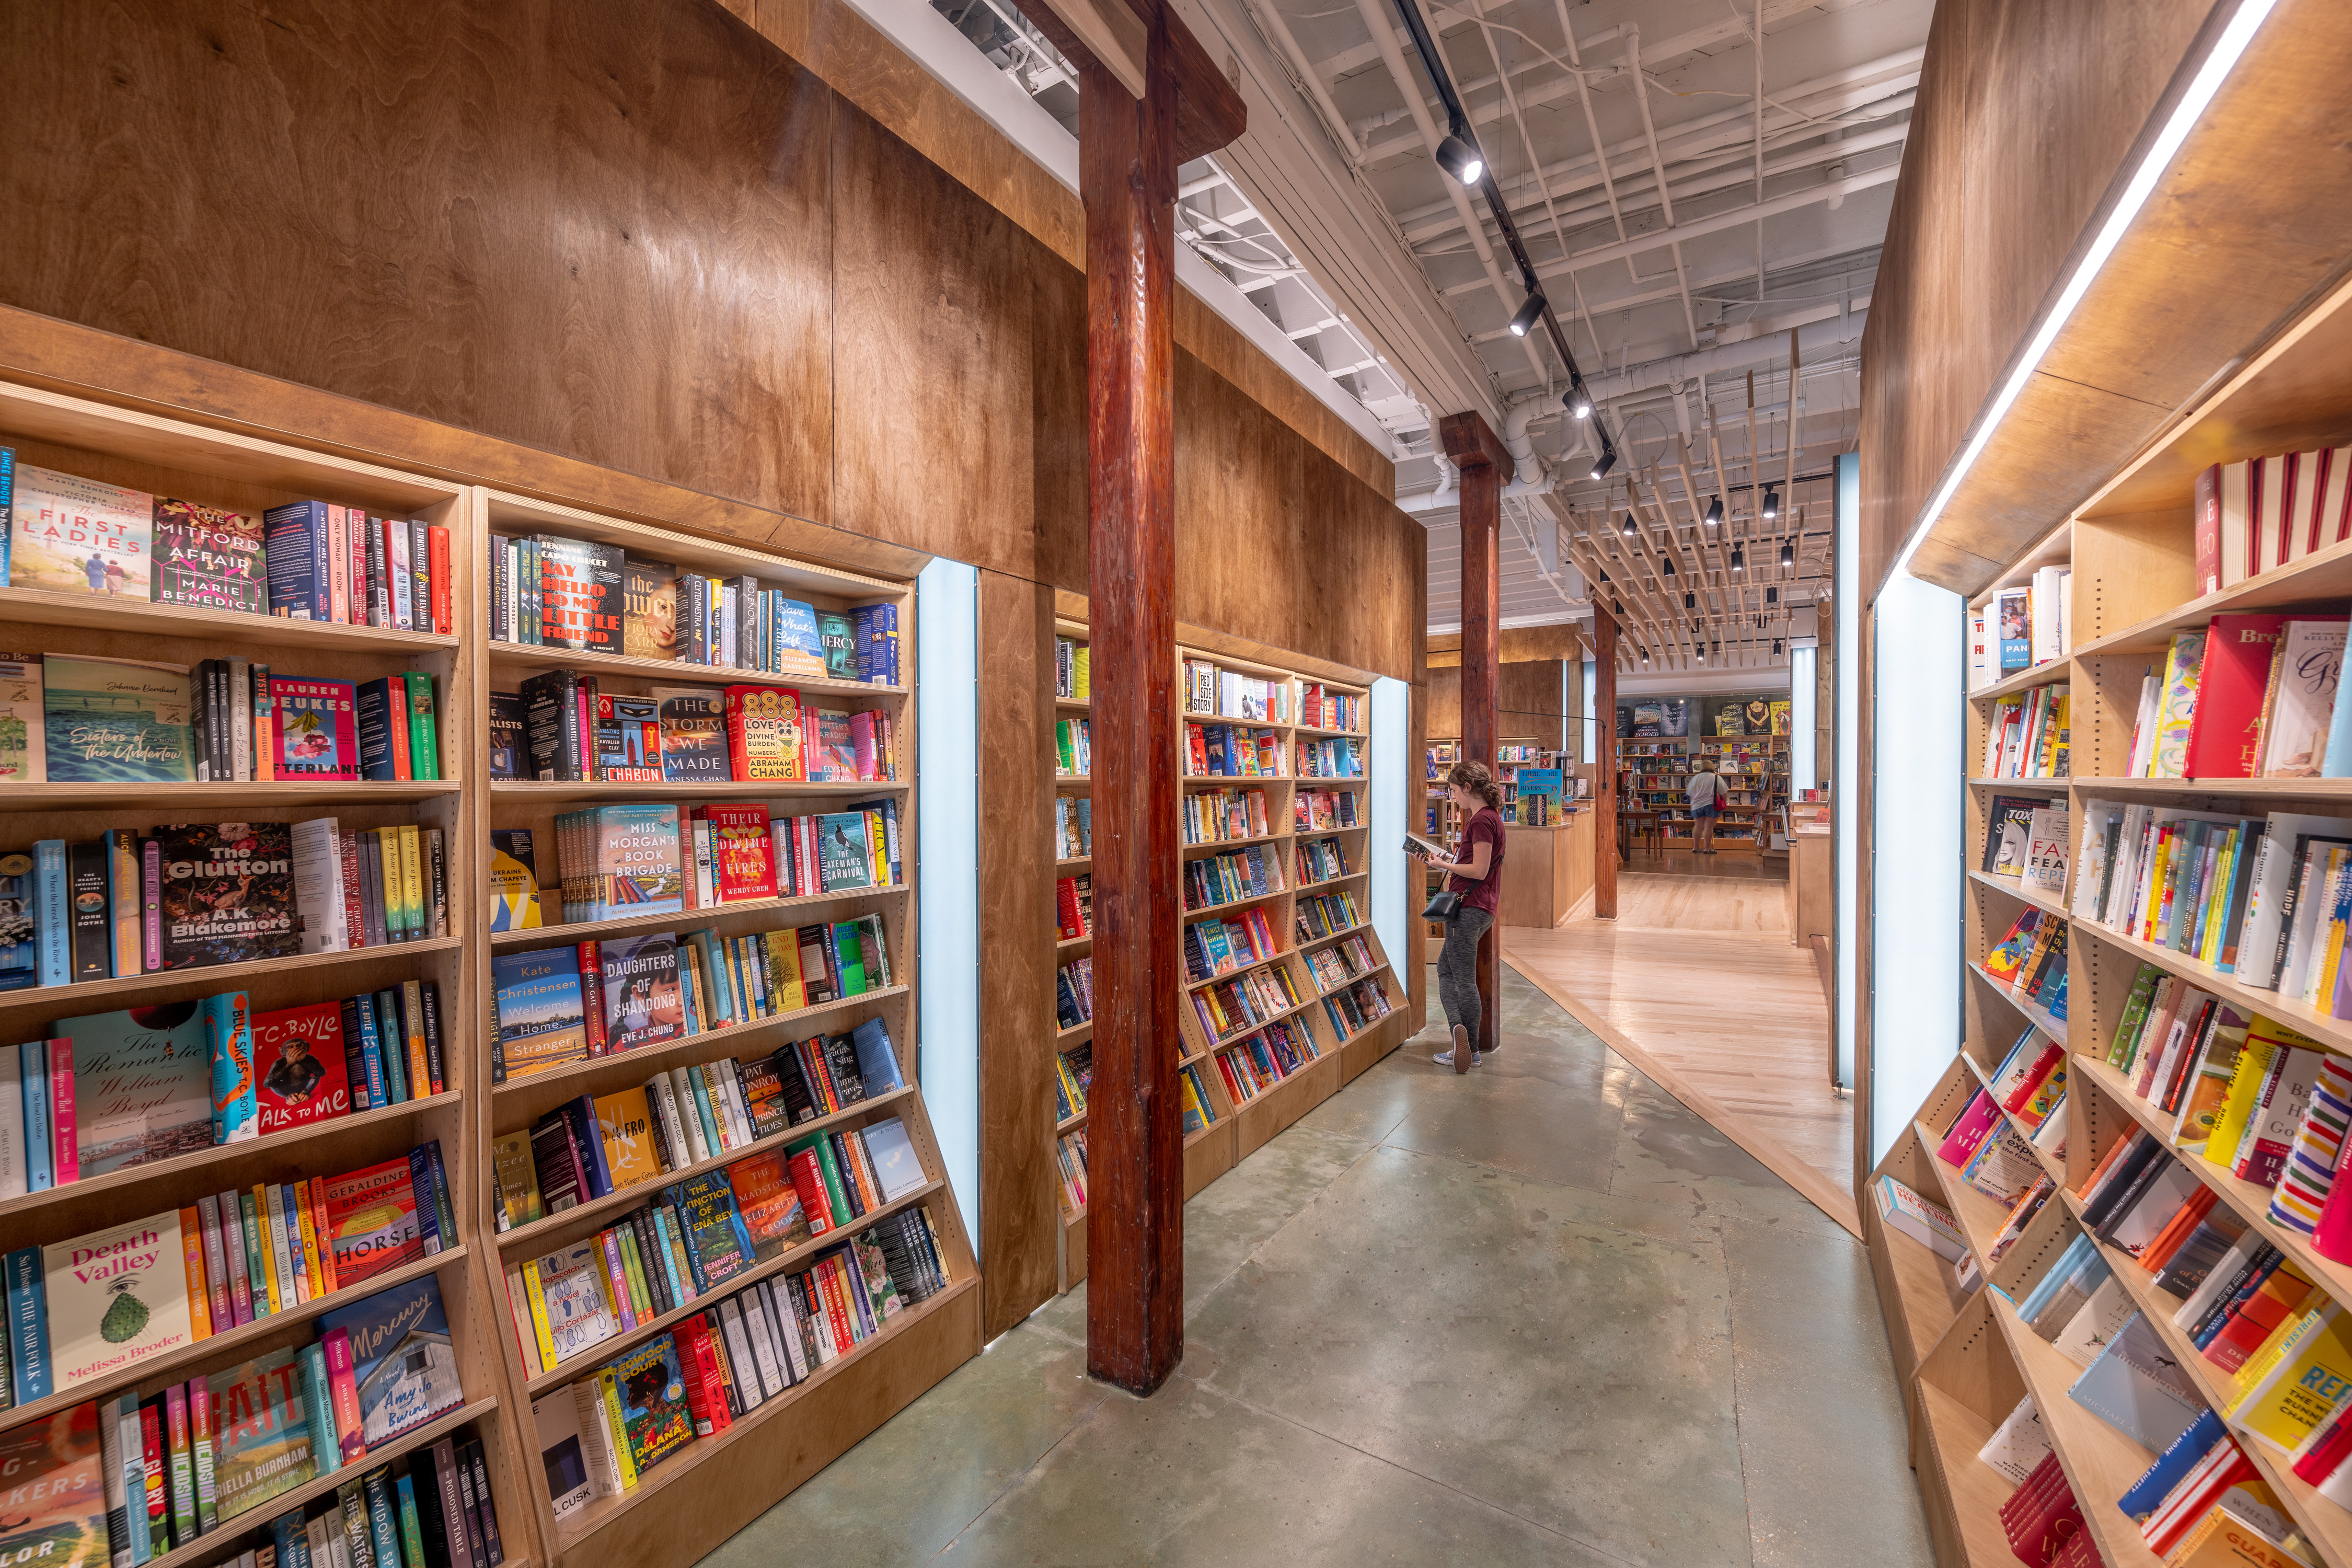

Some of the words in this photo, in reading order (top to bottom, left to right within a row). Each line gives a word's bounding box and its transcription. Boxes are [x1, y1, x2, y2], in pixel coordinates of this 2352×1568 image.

[47, 477, 76, 487] MARIE
[81, 485, 124, 498] BENEDICT
[64, 490, 107, 503] VICTORIA
[32, 487, 96, 504] CHRISTOPHER
[101, 503, 136, 514] MURRAY
[39, 508, 128, 536] FIRST
[194, 511, 225, 524] THE
[24, 520, 140, 553] LADIES
[156, 521, 260, 551] MITFORD
[541, 541, 582, 554] JENNINE
[169, 547, 249, 570] AFFAIR
[541, 551, 570, 563] CAPÓ
[572, 555, 607, 567] CRUCET
[541, 560, 576, 577] SAY
[542, 577, 606, 597] HELLO
[543, 593, 569, 606] TO
[573, 596, 601, 611] MY
[543, 607, 620, 630] LITTLE
[543, 626, 609, 643] FRIEND
[783, 663, 822, 673] CASTELLANO
[785, 655, 817, 665] ELIZABETH
[107, 682, 141, 691] Johnnie
[143, 684, 178, 696] Bernhard
[257, 673, 267, 704] OYSTER
[276, 684, 339, 696] LAUREN
[1201, 675, 1210, 686] RED
[1200, 687, 1211, 699] SIDE
[271, 697, 351, 711] BEUKES
[672, 699, 708, 712] THE
[742, 690, 798, 720] 888
[1194, 698, 1210, 711] STORY
[660, 718, 723, 732] STORM
[745, 720, 774, 730] LOVE
[70, 727, 126, 744] Sisters
[134, 729, 147, 750] of
[79, 745, 111, 761] the
[114, 744, 182, 763] Undertow
[668, 757, 721, 770] MADE
[608, 768, 660, 782] CHABON
[750, 768, 792, 778] CHANG
[631, 822, 656, 834] MISS
[721, 813, 760, 825] THEIR
[331, 825, 340, 855] BYCATCH
[609, 835, 675, 849] MORGAN'S
[719, 837, 768, 851] DIVINE
[874, 821, 884, 852] FLUX
[2264, 821, 2273, 849] Mixed
[210, 847, 251, 860] The
[625, 850, 664, 862] BOOK
[169, 859, 289, 879] Glutton
[616, 863, 672, 877] BRIGADE
[727, 861, 766, 874] FIRES
[827, 866, 864, 881] CARNIVAL
[2256, 852, 2267, 885] Signals
[212, 906, 252, 921] A.K.
[171, 917, 291, 938] Blakemore
[1206, 926, 1220, 935] EMILY
[1208, 934, 1224, 943] GIFFIN
[521, 965, 551, 977] Kate
[607, 954, 675, 978] DAUGHTERS
[498, 981, 576, 1001] Christensen
[637, 977, 651, 993] OF
[508, 1000, 570, 1018] Welcome
[614, 994, 676, 1019] SHANDONG
[232, 1010, 246, 1038] BLUE
[520, 1021, 563, 1036] Home,
[621, 1031, 637, 1044] EVE
[639, 1030, 645, 1040] J.
[648, 1023, 674, 1036] CHUNG
[117, 1032, 160, 1055] The
[514, 1037, 571, 1057] Stranger
[74, 1047, 202, 1078] Romantic
[234, 1040, 249, 1075] SKIES
[368, 1057, 382, 1097] TERRANAUTS
[2023, 1068, 2038, 1083] Lucy
[2228, 1056, 2243, 1089] FLUKE
[93, 1073, 186, 1098] William
[2016, 1078, 2030, 1092] Jones
[99, 1088, 176, 1119] Boyd
[682, 1077, 694, 1106] TREMOR
[695, 1124, 703, 1138] COLE
[755, 1106, 785, 1123] PRINCE
[758, 1121, 782, 1135] TIDES
[2014, 1152, 2030, 1164] first
[329, 1170, 406, 1200] GERALDINE
[738, 1175, 792, 1204] MADSTONE
[1980, 1176, 1991, 1184] heidi
[1990, 1181, 2010, 1194] murkoff
[342, 1185, 397, 1209] BROOKS
[746, 1194, 799, 1224] ELIZABETH
[761, 1214, 794, 1236] CROOK
[71, 1229, 159, 1267] Death
[336, 1225, 415, 1265] HORSE
[73, 1250, 161, 1284] Valley
[704, 1250, 741, 1273] JENNIFER
[710, 1262, 739, 1279] CROFT
[539, 1264, 581, 1285] Hopscotch
[348, 1293, 433, 1363] Mercury
[566, 1308, 600, 1329] Cortázar
[66, 1355, 127, 1382] Melissa
[130, 1333, 184, 1359] Broder
[335, 1341, 344, 1369] Milkman
[620, 1354, 665, 1382] COURT
[2082, 1394, 2126, 1427] MICHAEL
[651, 1430, 692, 1458] DAMERON
[2164, 1436, 2183, 1456] MONK
[257, 1445, 307, 1478] BURNHAM
[2151, 1459, 2161, 1472] JAY
[2131, 1471, 2151, 1493] SHETTY
[562, 1487, 591, 1511] CUSK
